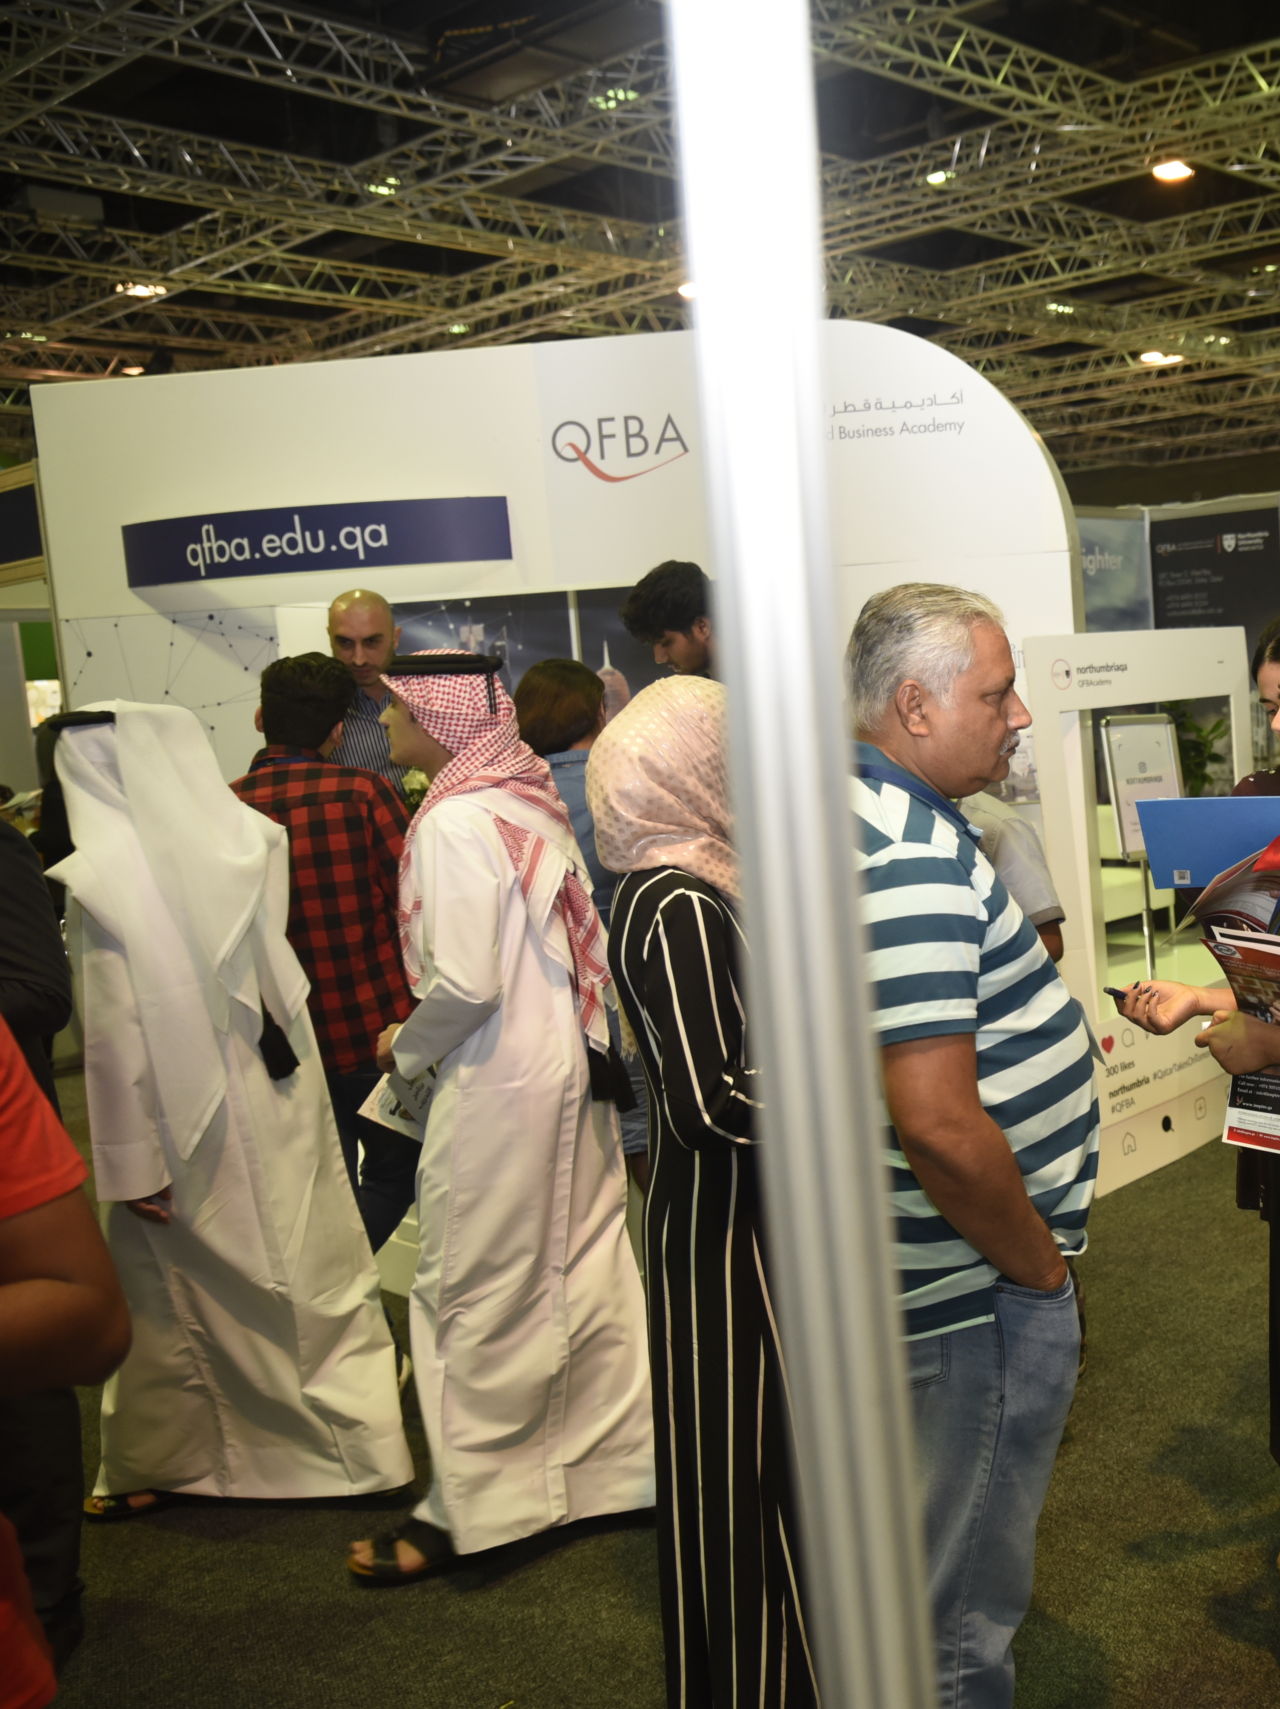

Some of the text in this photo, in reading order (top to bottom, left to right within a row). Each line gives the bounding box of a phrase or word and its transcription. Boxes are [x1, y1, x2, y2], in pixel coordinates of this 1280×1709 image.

[838, 423, 896, 440] Business
[899, 416, 966, 436] Academy
[551, 413, 690, 478] QFBA
[186, 514, 389, 577] qfba.edu.qa
[1105, 1064, 1119, 1079] 300
[1120, 1060, 1136, 1073] likes
[1108, 1075, 1151, 1100] northumbria
